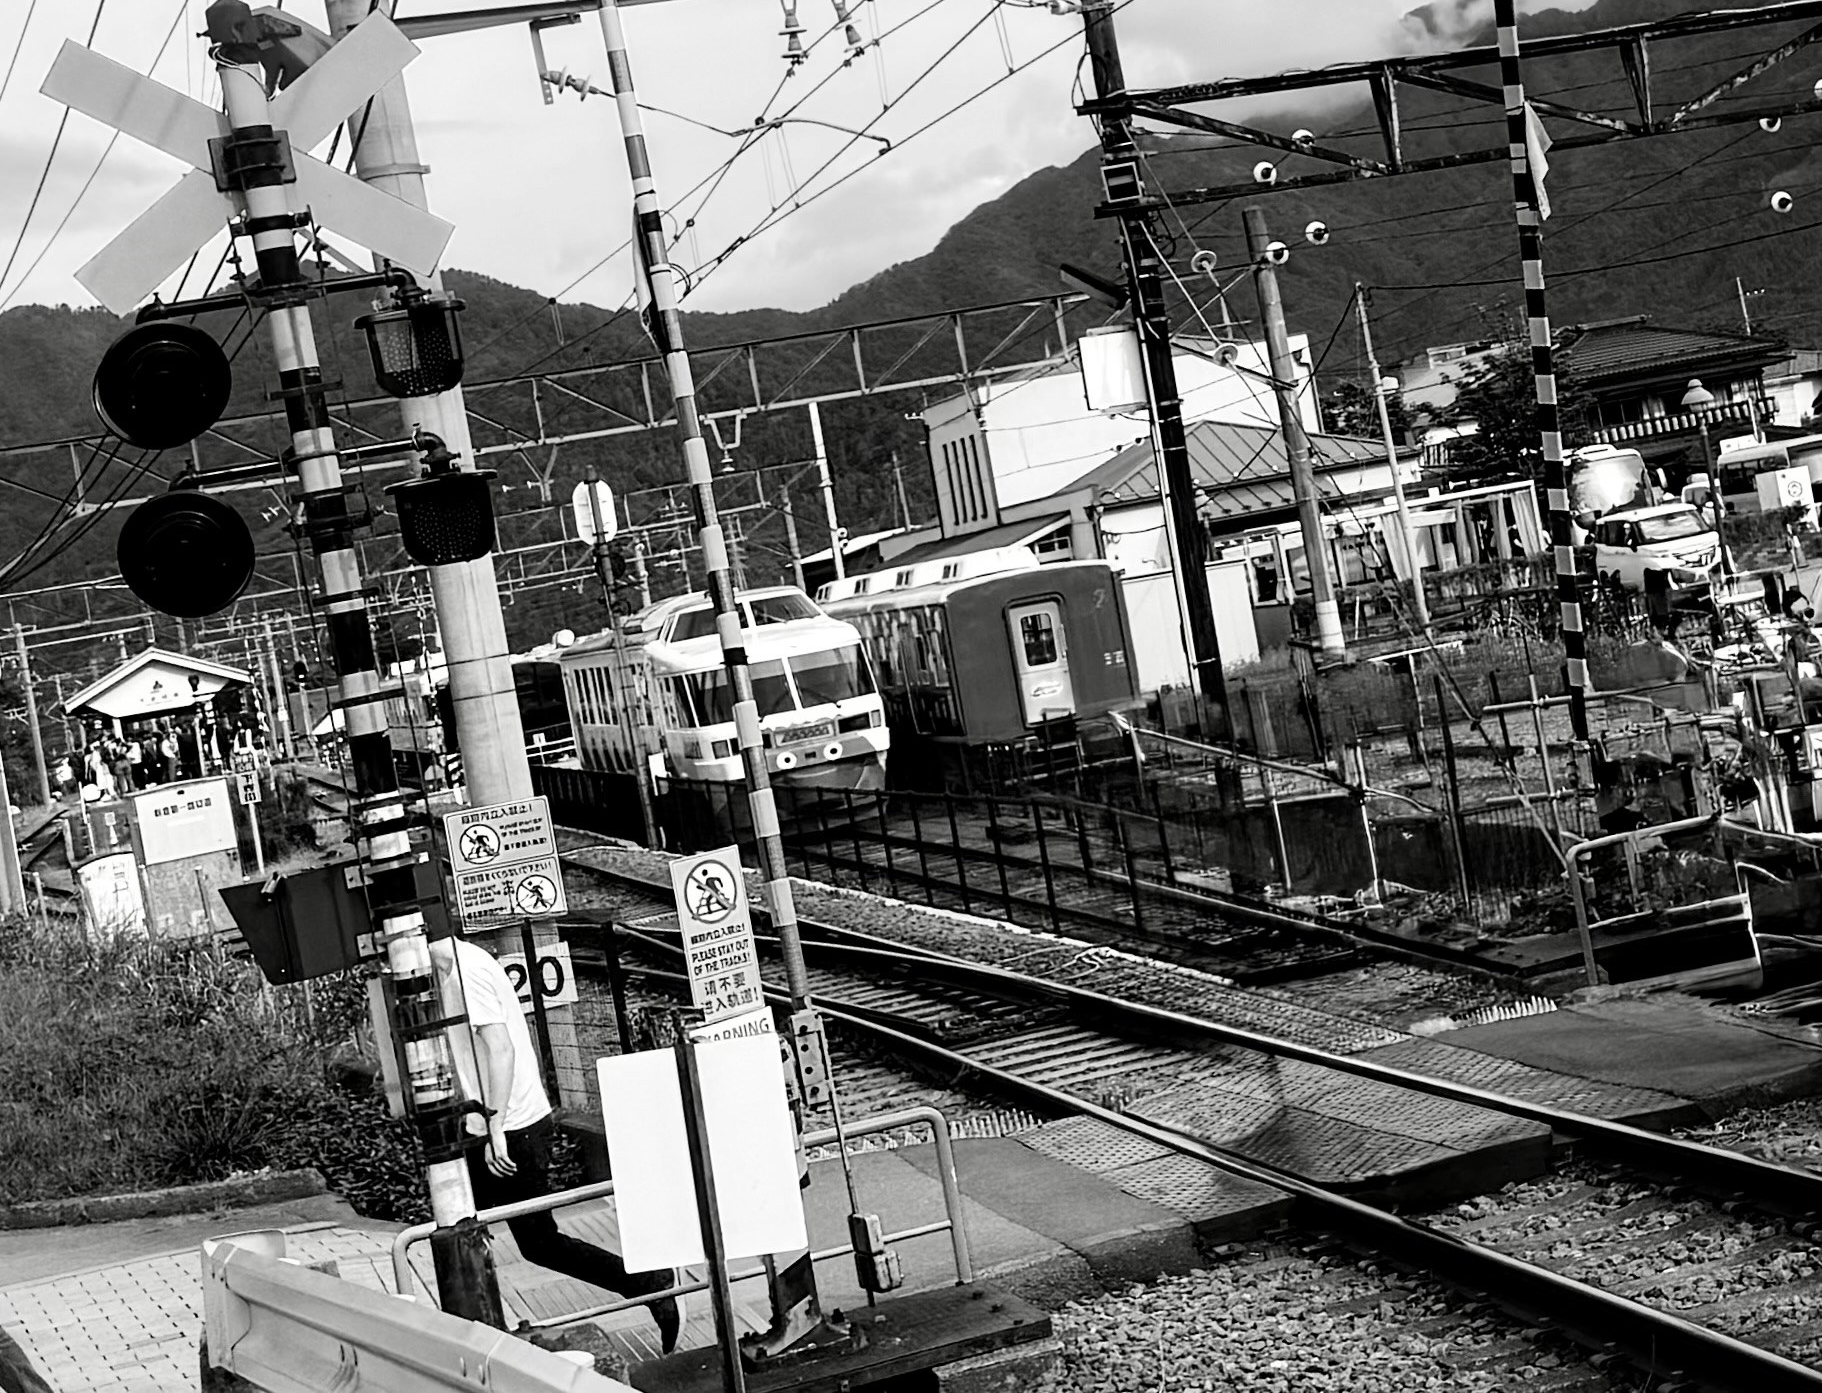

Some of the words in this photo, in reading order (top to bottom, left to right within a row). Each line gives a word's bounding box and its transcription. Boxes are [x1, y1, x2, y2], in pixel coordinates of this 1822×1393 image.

[691, 947, 717, 963] PLEASE
[717, 943, 735, 956] STAY
[735, 938, 749, 951] OUT
[504, 956, 565, 1003] 20
[693, 964, 703, 975] OF
[705, 961, 719, 973] THE
[708, 1017, 771, 1042] ARNING
